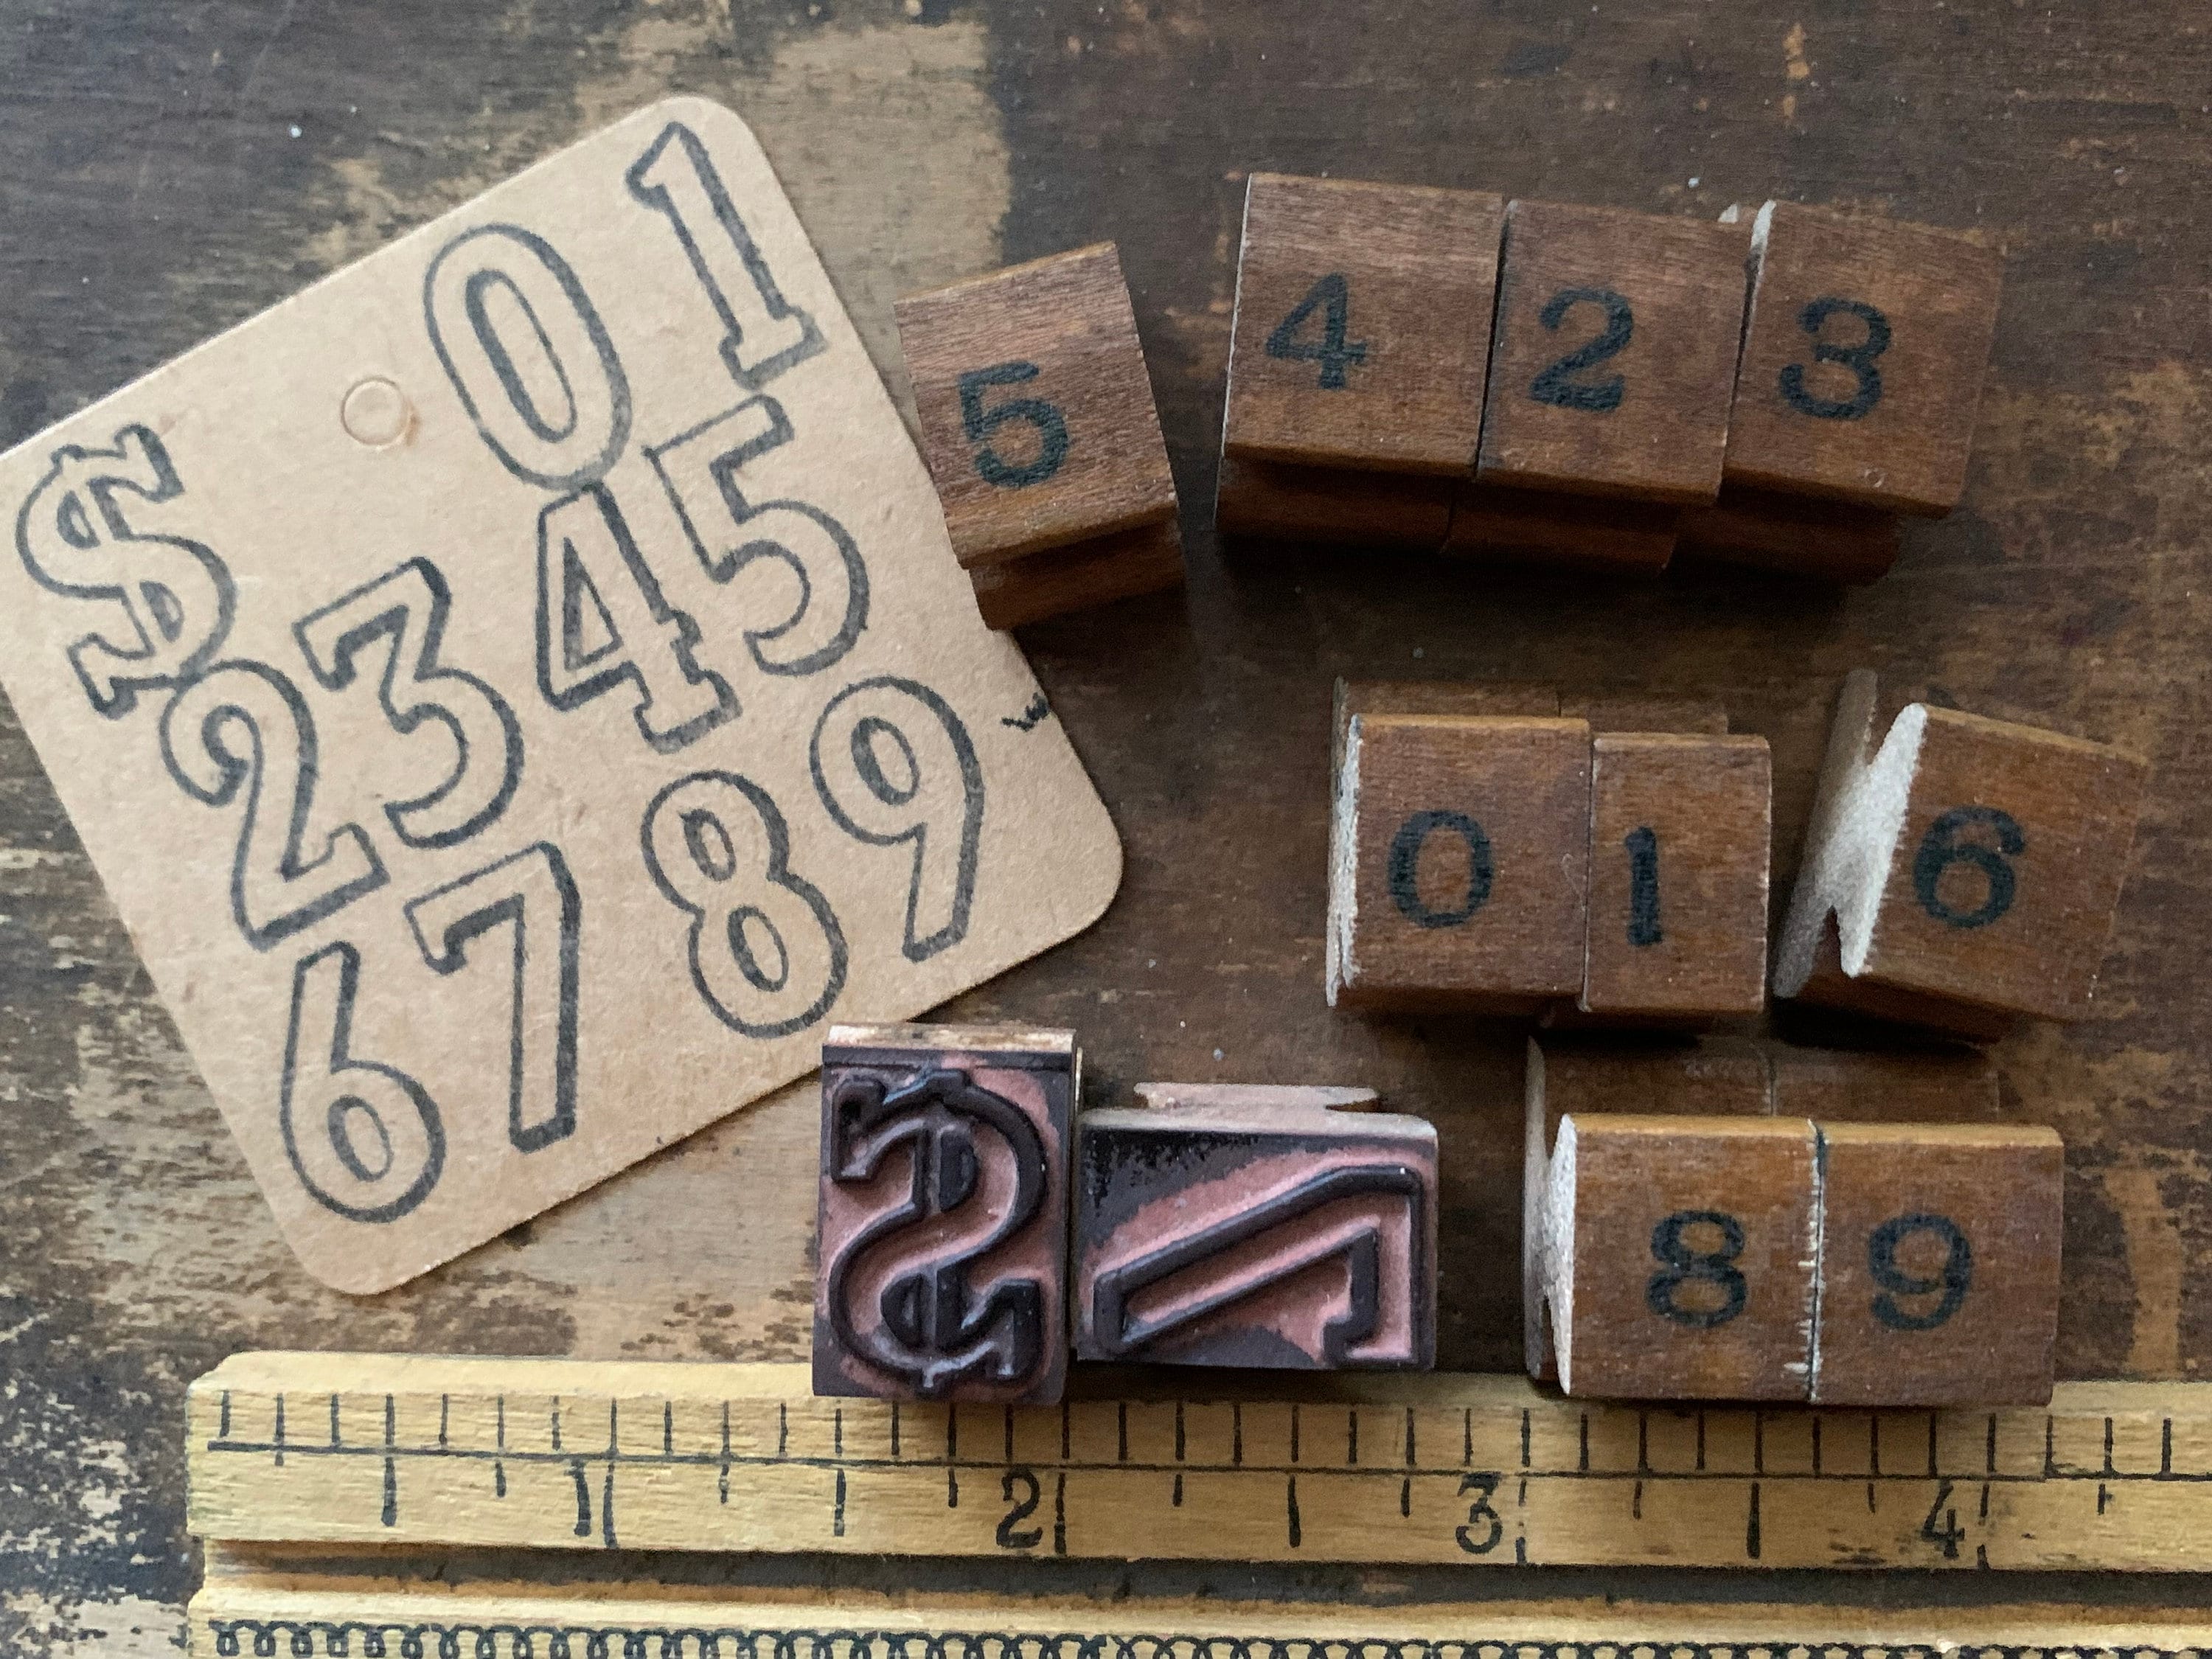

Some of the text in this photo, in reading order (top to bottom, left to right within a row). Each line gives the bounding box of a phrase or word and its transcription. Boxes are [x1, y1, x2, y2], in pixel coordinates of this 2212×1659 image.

[1264, 273, 1368, 389] 4
[1528, 288, 1633, 412] 2
[1778, 296, 1891, 420] 3
[959, 361, 1071, 490] 5
[15, 423, 236, 719] $
[1388, 810, 1493, 928] 0
[1624, 827, 1663, 946] 1
[1917, 806, 2025, 930] 6
[1646, 1209, 1748, 1327] 8
[1868, 1214, 1972, 1330] 9
[996, 1468, 1043, 1548] 2
[1455, 1472, 1503, 1554] 3
[1921, 1484, 1965, 1559] 4
